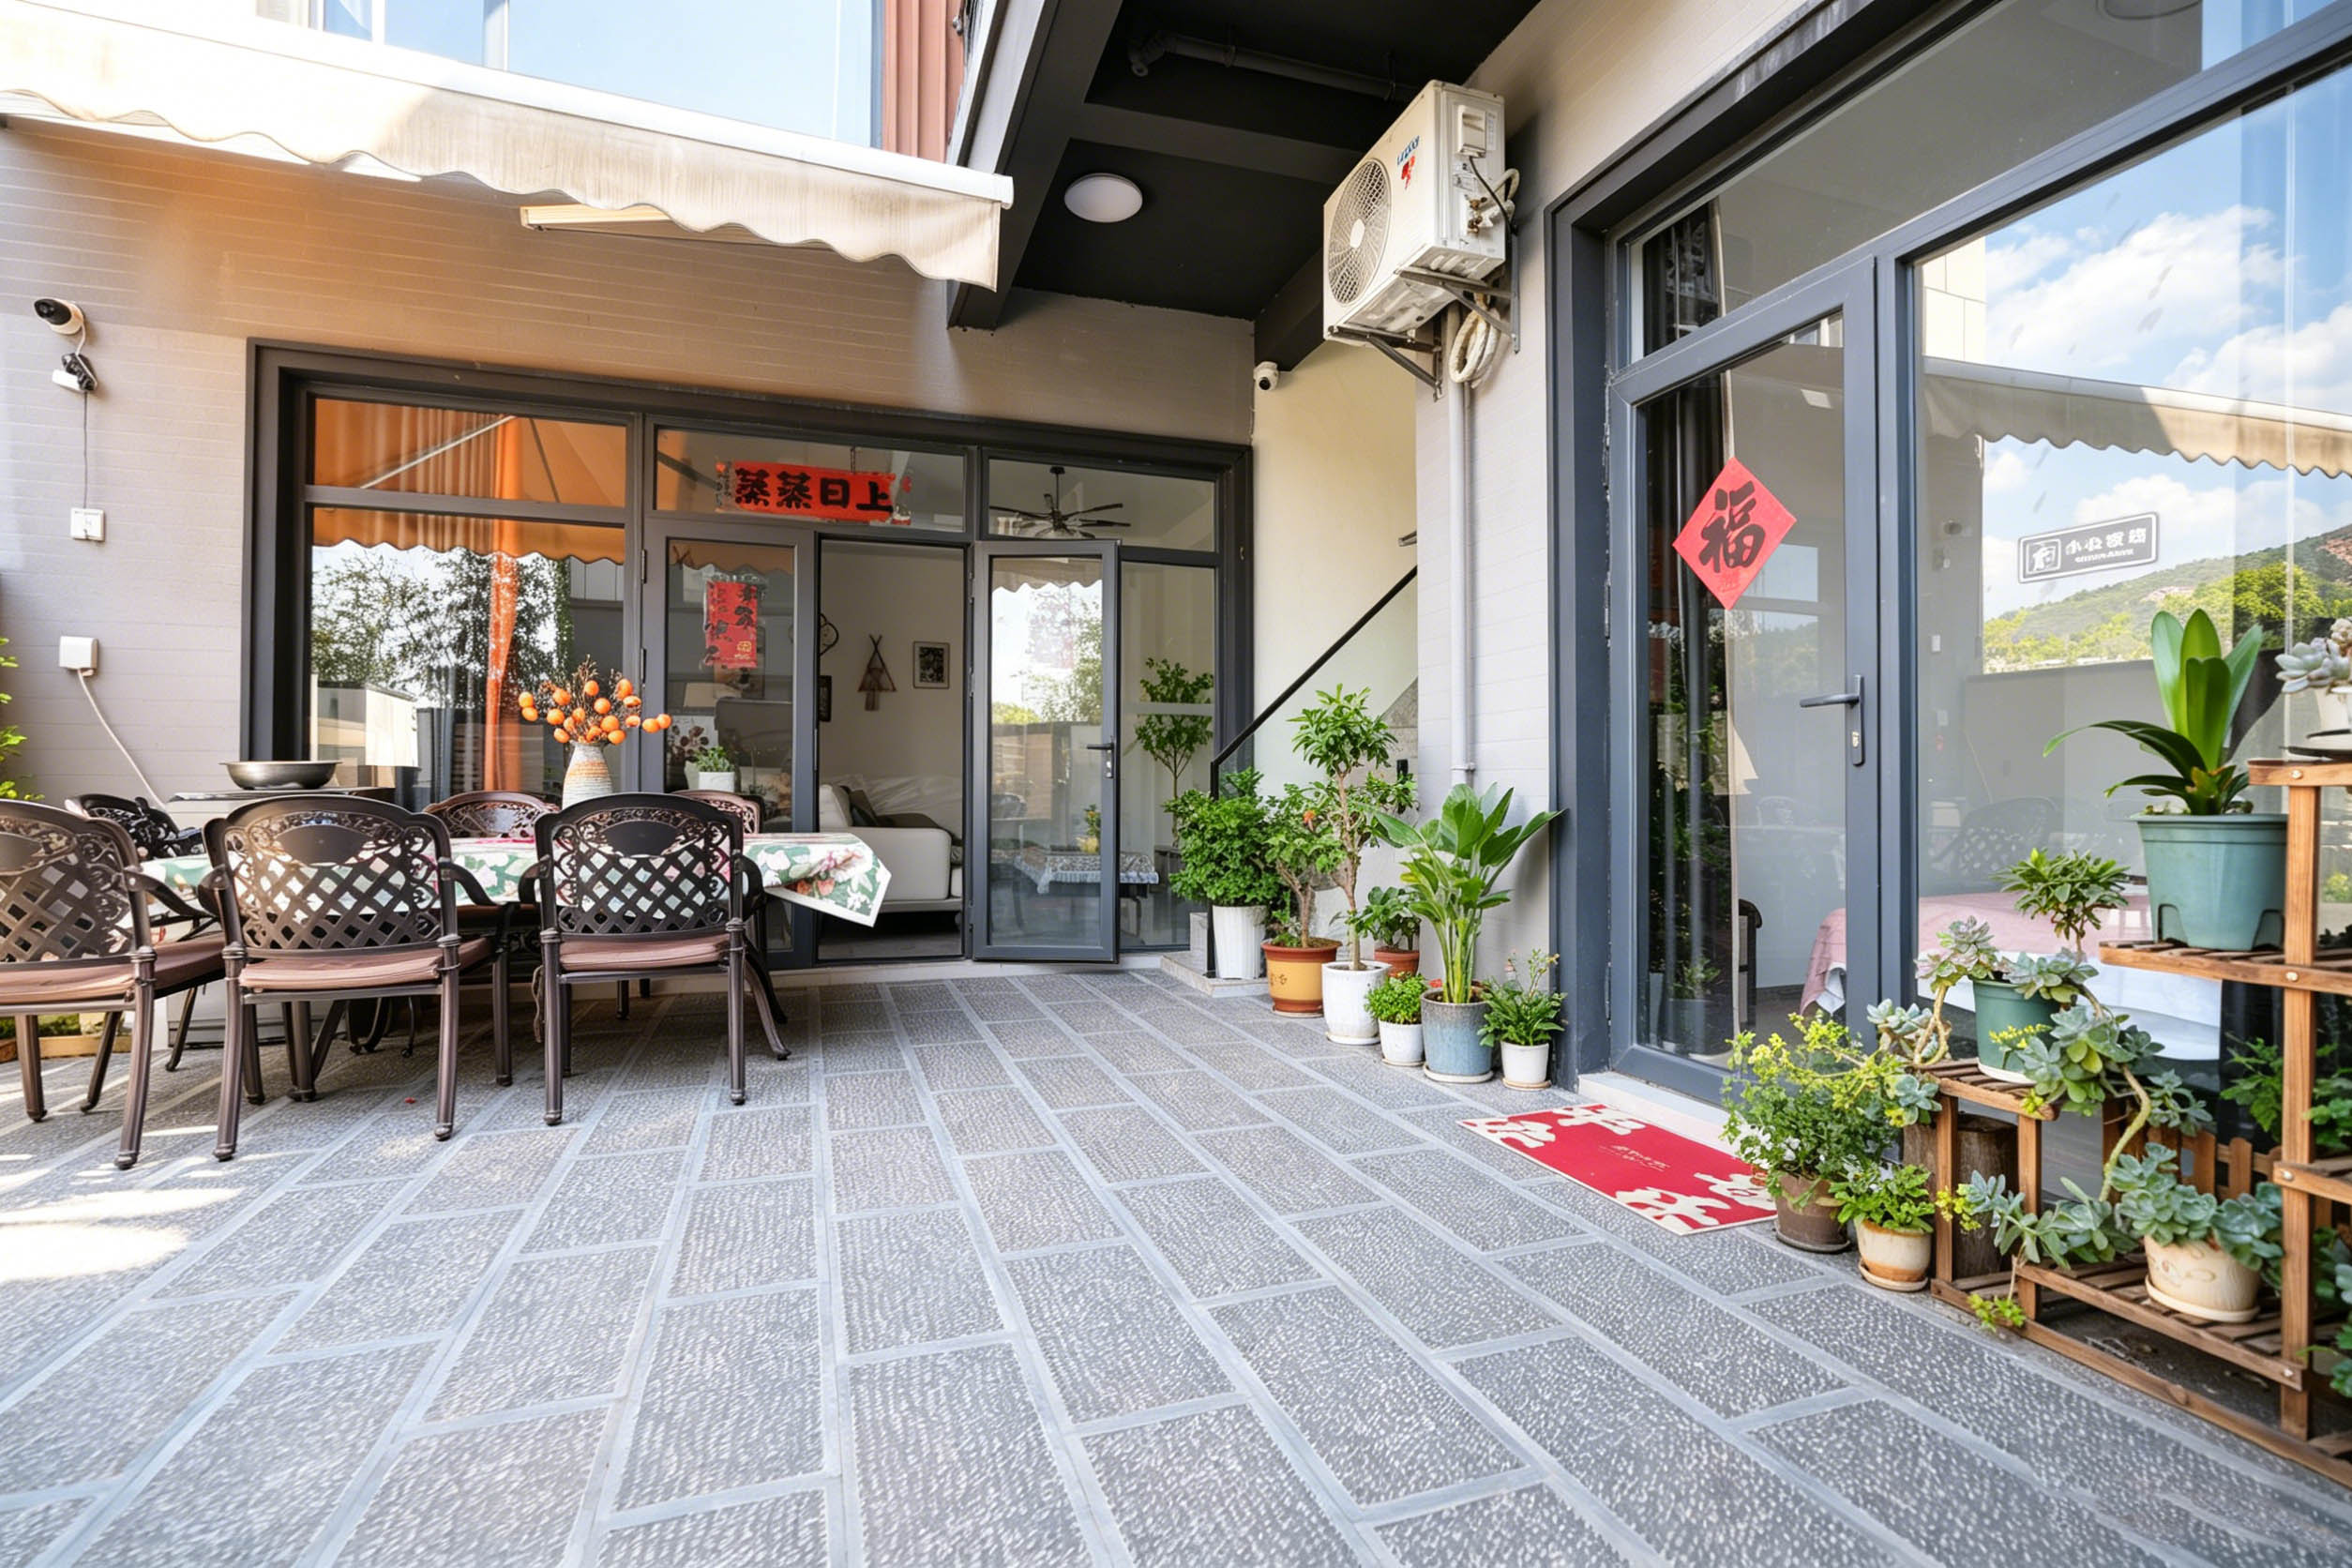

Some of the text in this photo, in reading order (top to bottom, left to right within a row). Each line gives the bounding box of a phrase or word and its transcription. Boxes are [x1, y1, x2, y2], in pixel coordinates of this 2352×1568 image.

[735, 468, 894, 513] 蒸蒸日上
[1698, 480, 1766, 573] 福
